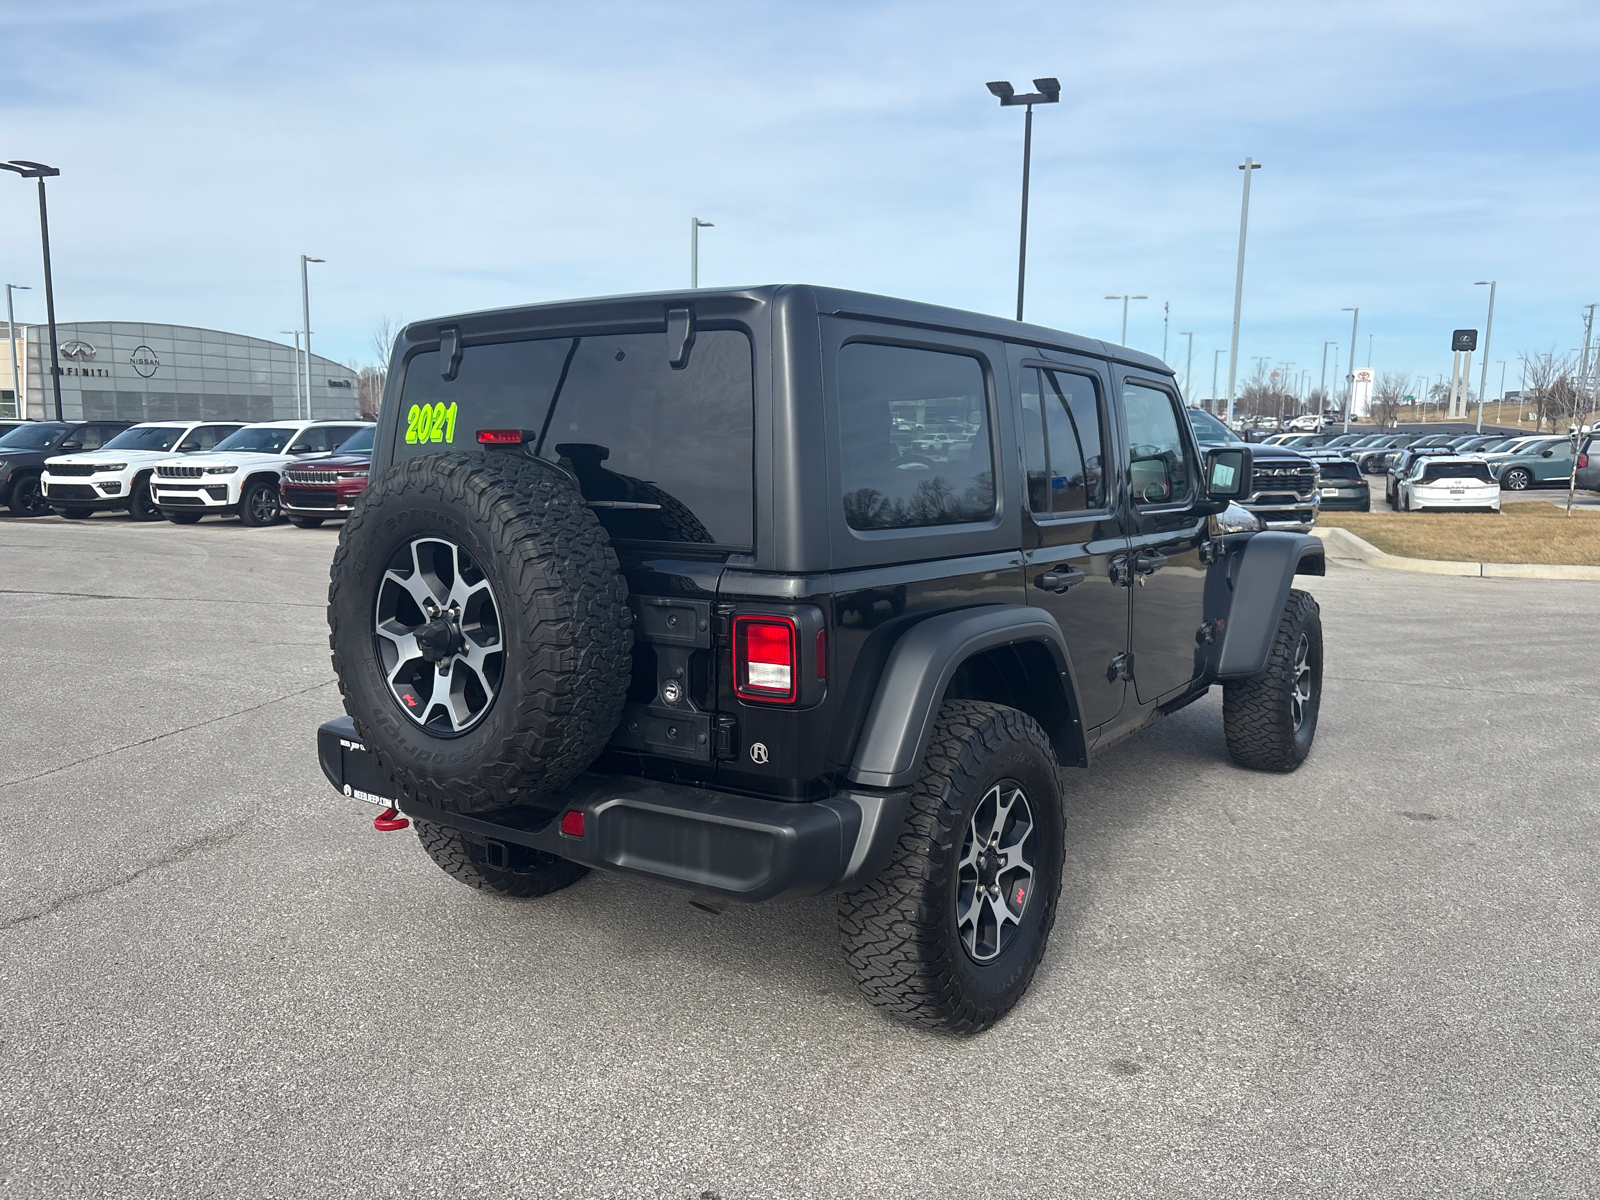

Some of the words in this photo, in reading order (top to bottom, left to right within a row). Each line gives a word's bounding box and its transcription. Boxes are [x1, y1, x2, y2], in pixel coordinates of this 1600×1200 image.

[130, 358, 160, 366] NISSAN
[405, 401, 458, 444] 2021
[1260, 468, 1298, 476] RAM
